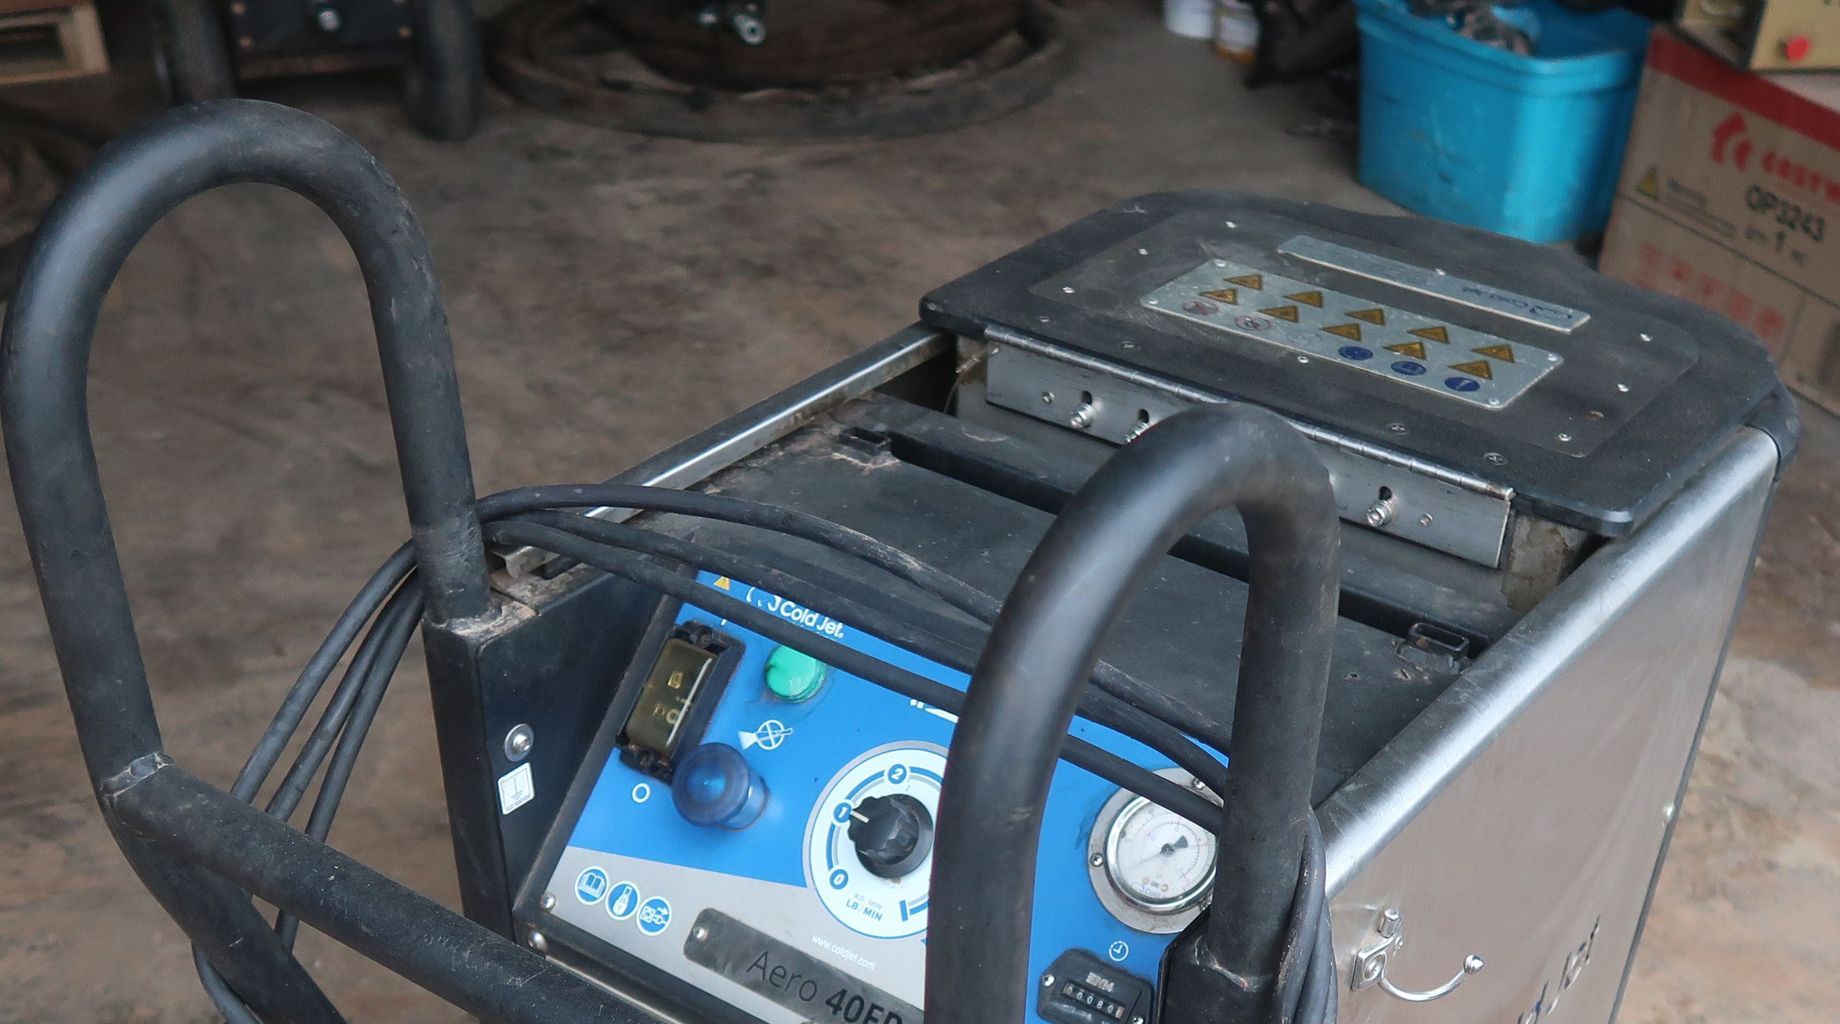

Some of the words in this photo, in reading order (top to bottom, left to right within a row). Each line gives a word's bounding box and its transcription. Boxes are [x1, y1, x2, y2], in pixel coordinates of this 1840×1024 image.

[780, 600, 820, 627] Cold
[811, 933, 877, 971] www.coldjet.com
[745, 950, 818, 1003] Aero
